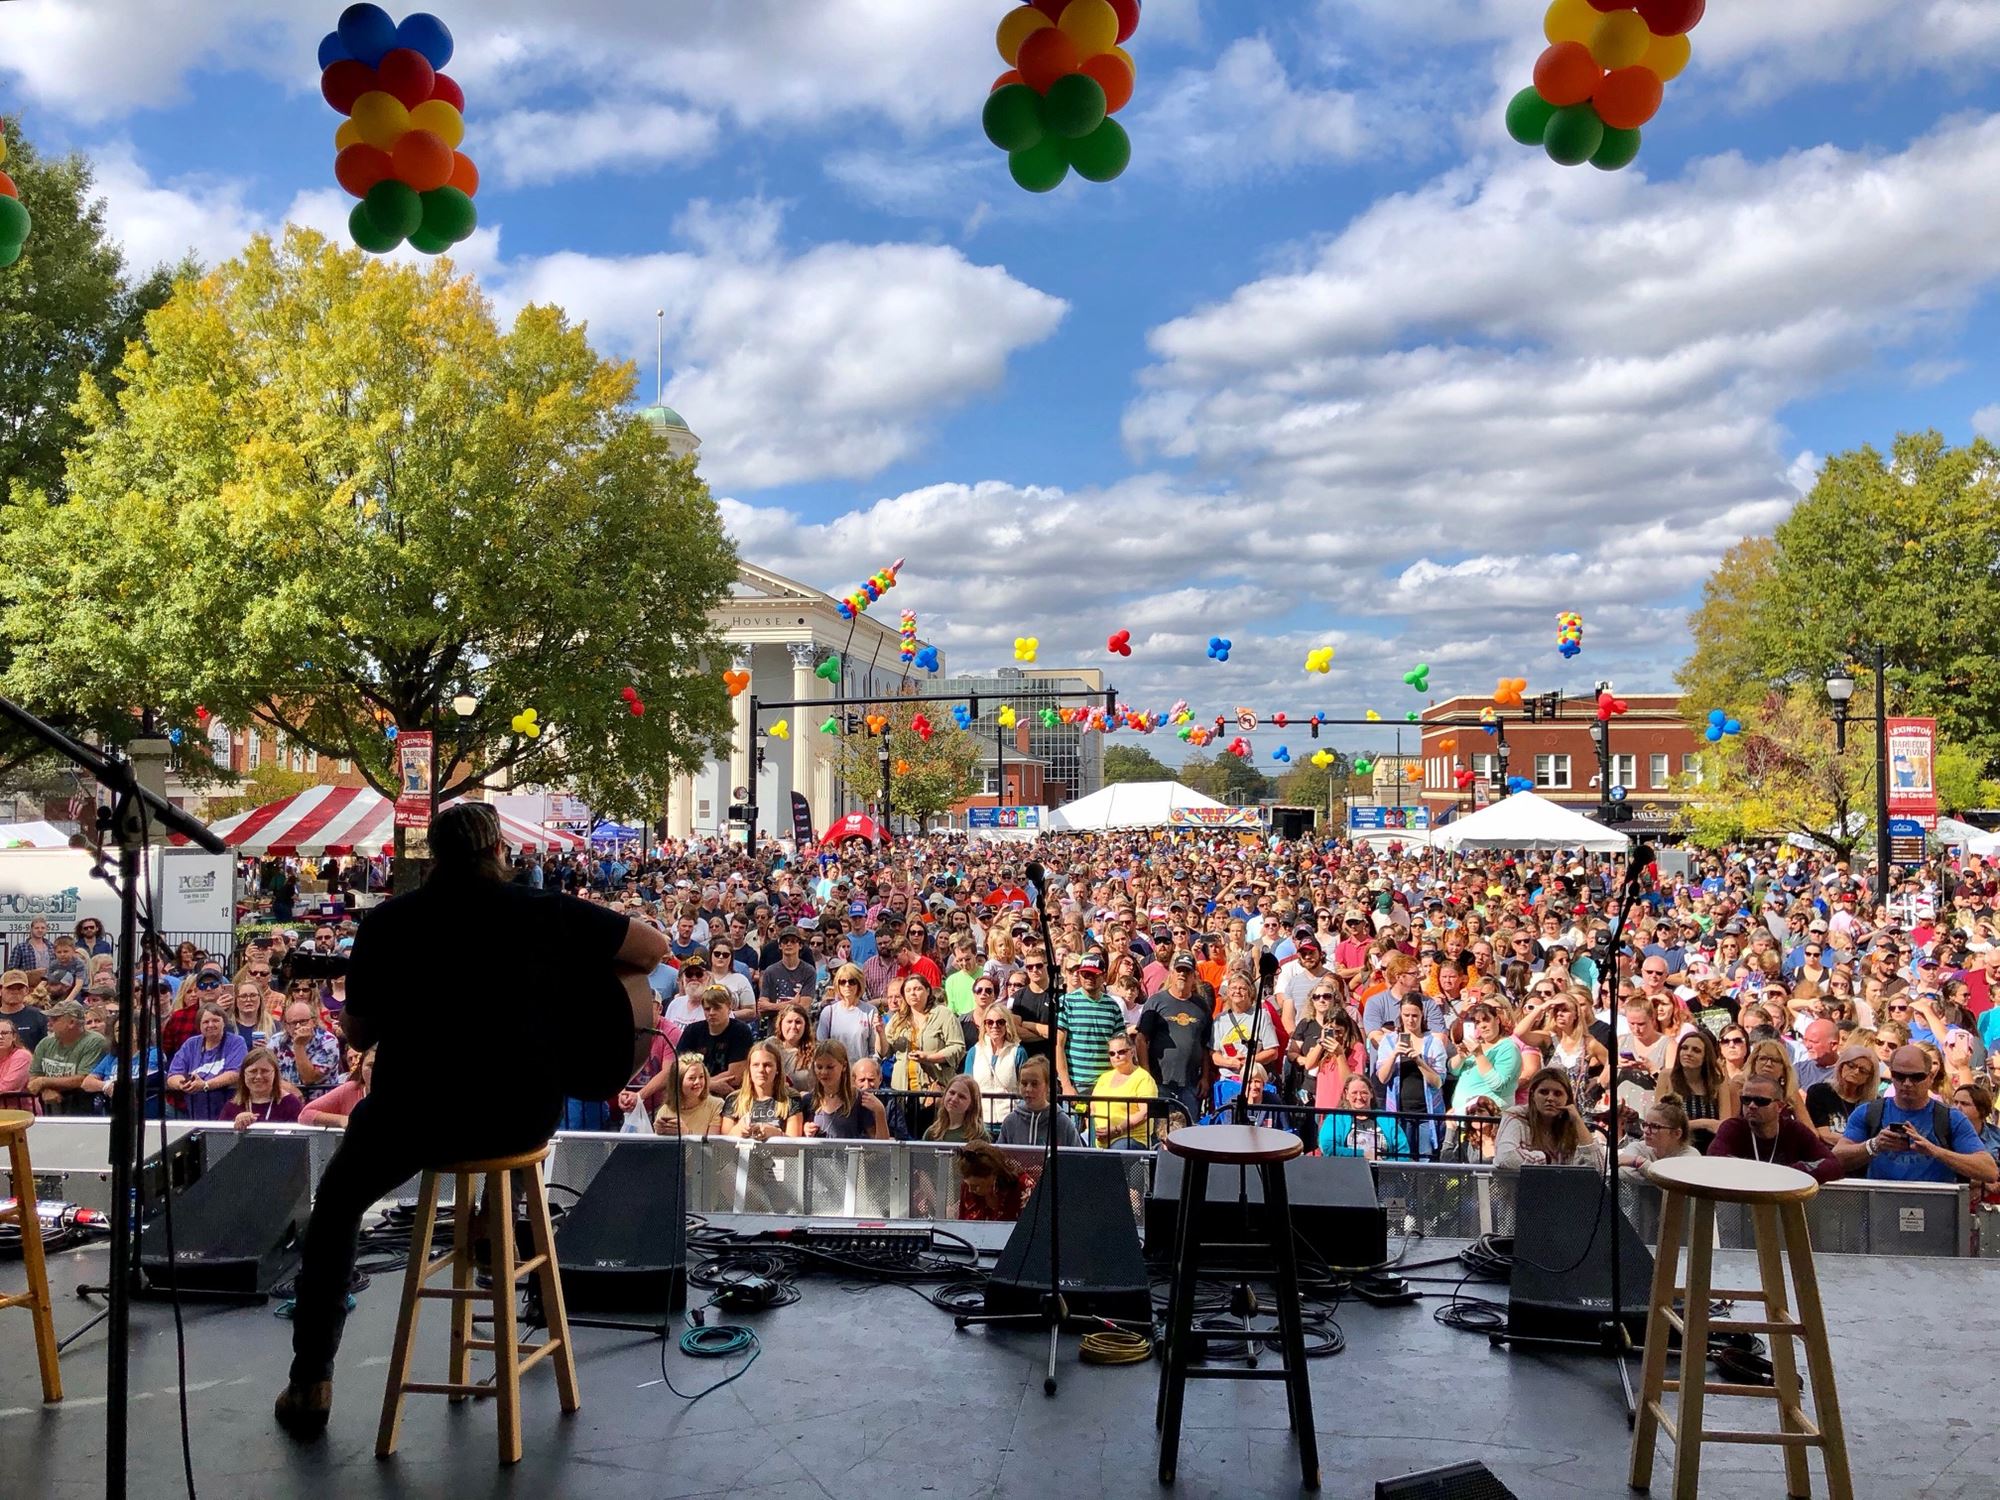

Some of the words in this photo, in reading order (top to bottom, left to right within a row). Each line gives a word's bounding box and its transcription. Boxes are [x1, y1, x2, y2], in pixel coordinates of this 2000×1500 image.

[732, 616, 781, 626] HOVSE
[1889, 725, 1933, 736] LEXINGTON
[1892, 739, 1929, 749] BARBECUE
[1201, 815, 1227, 823] TENT
[0, 894, 77, 914] POSSE
[221, 906, 229, 918] 12
